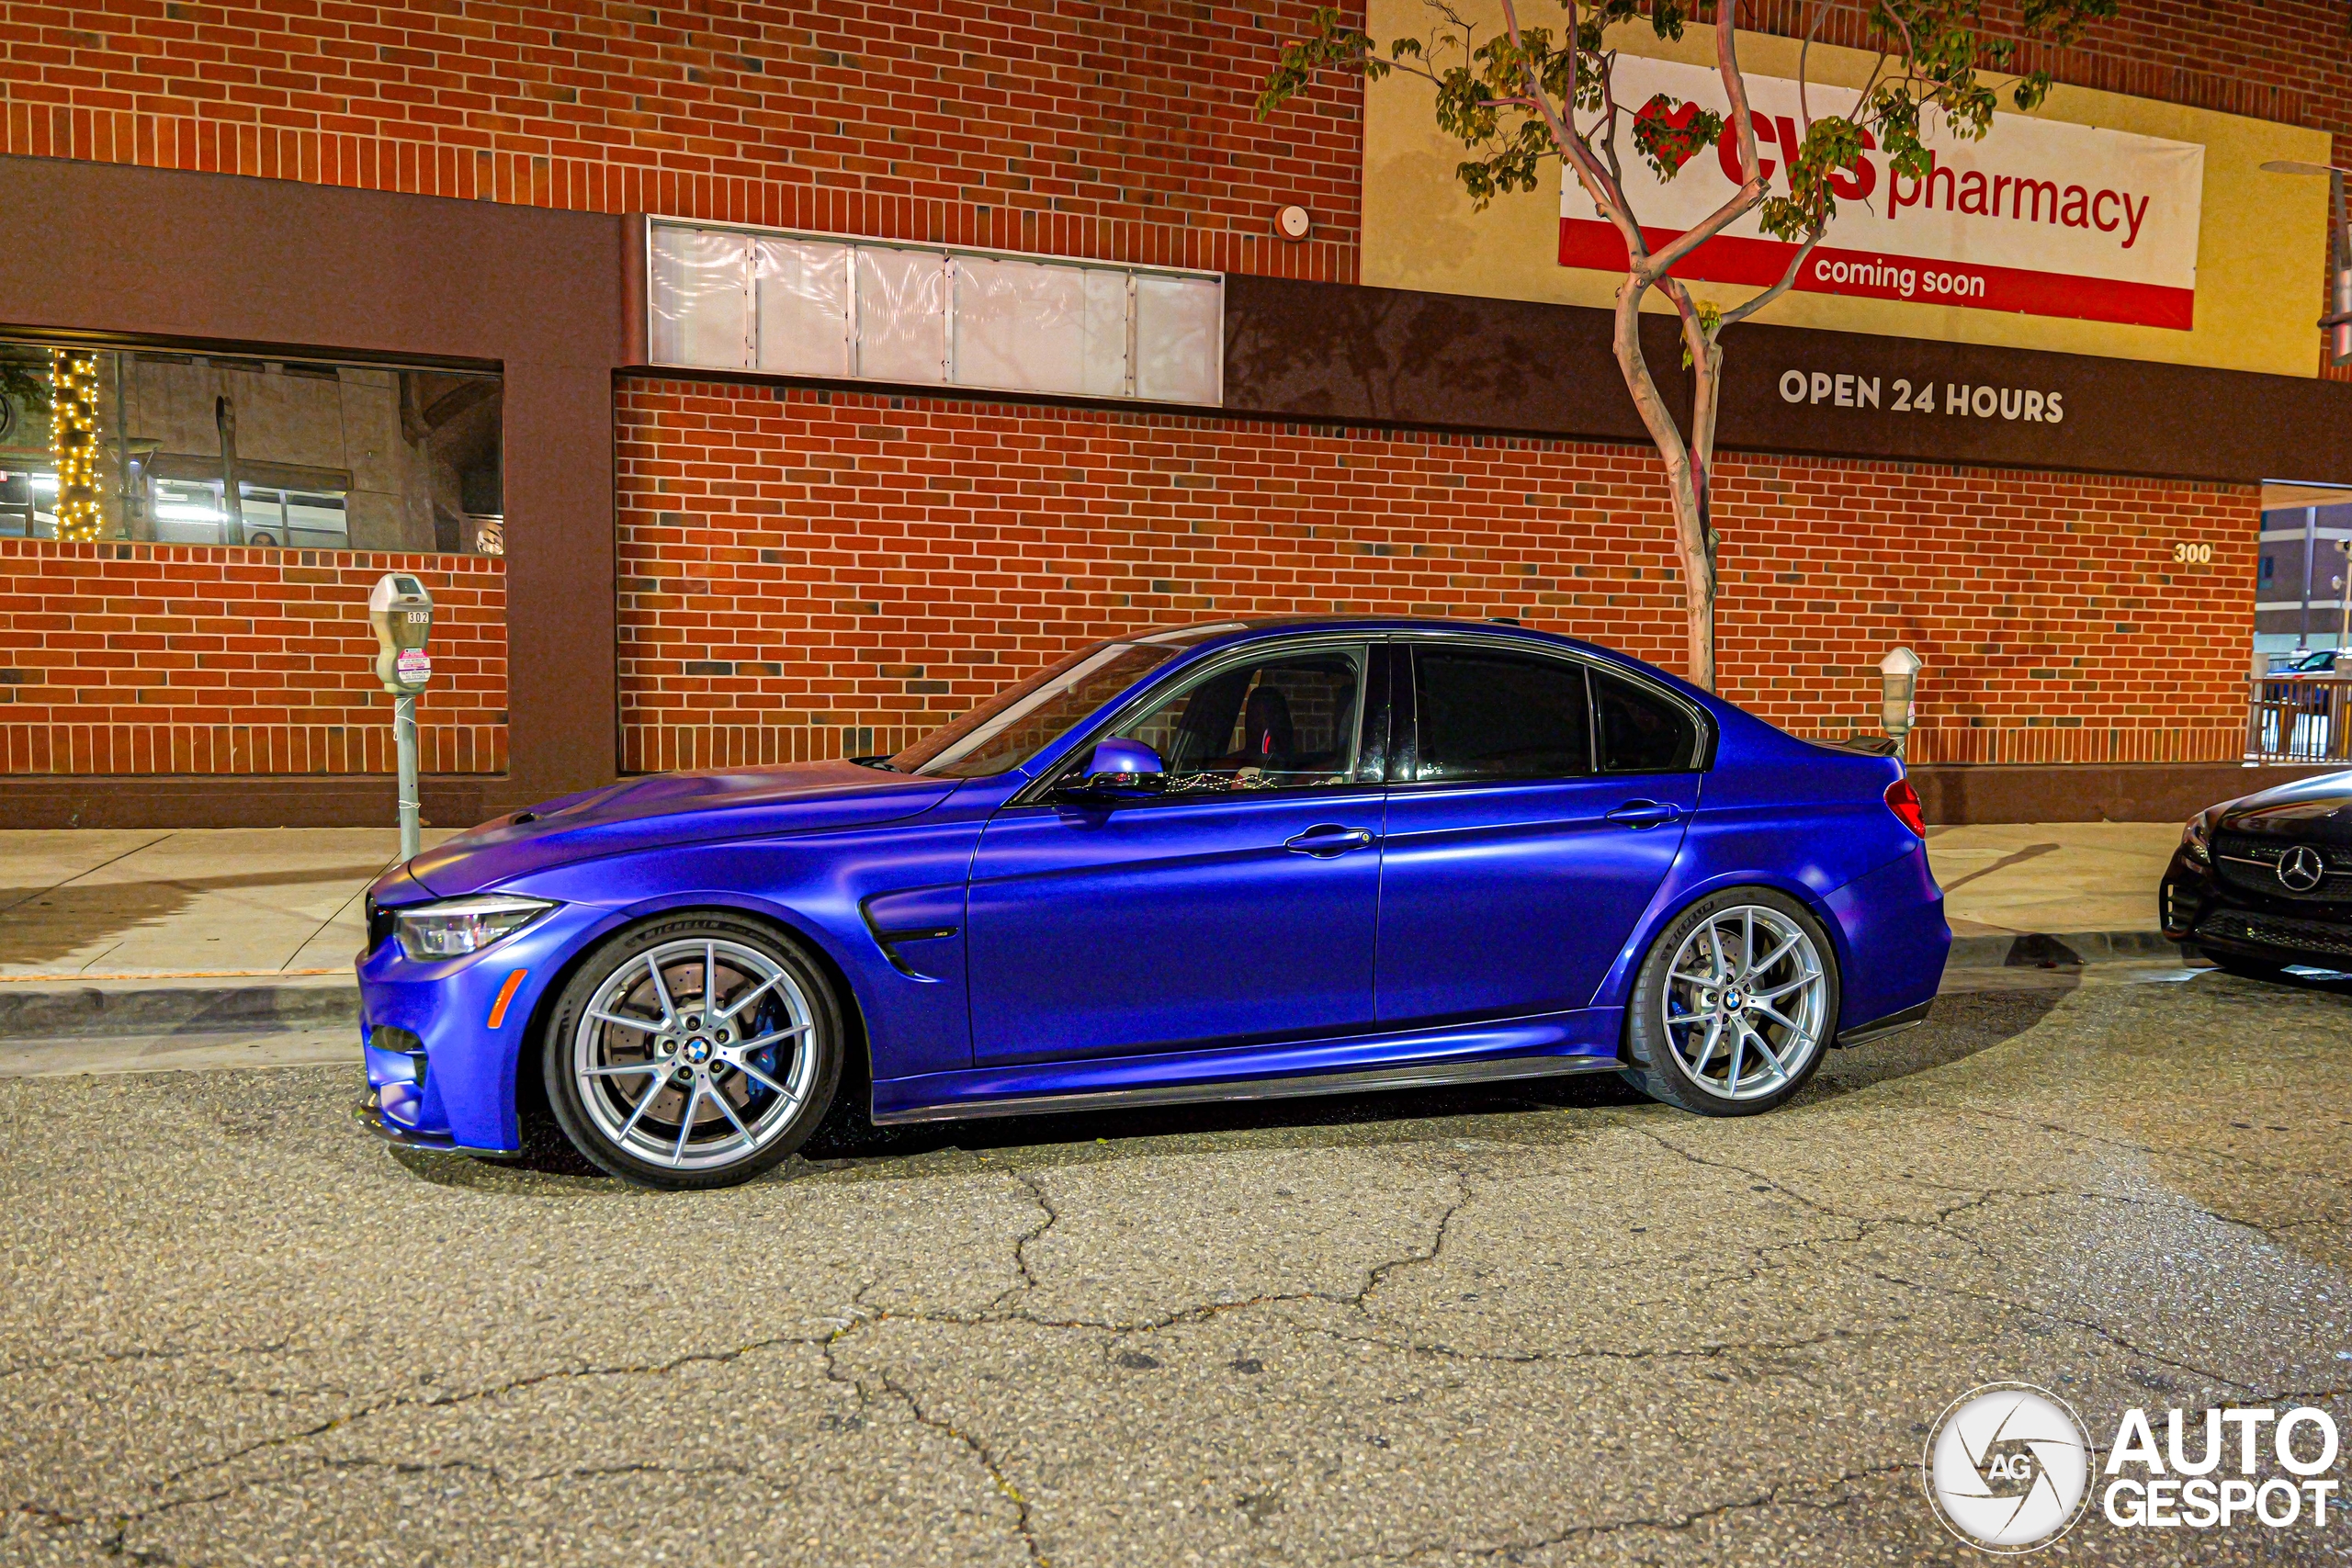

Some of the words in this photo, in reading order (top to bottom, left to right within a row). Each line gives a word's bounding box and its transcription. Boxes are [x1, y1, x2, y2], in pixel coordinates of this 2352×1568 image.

[1887, 149, 2150, 249] pharmacy
[1815, 258, 1916, 297] coming
[1922, 271, 1984, 297] soon
[1779, 369, 1880, 409] OPEN
[1891, 378, 1935, 412] 24
[1946, 383, 2064, 423] HOURS
[2174, 543, 2211, 563] 300
[409, 613, 427, 623] 302
[645, 920, 720, 940] MICHELIN
